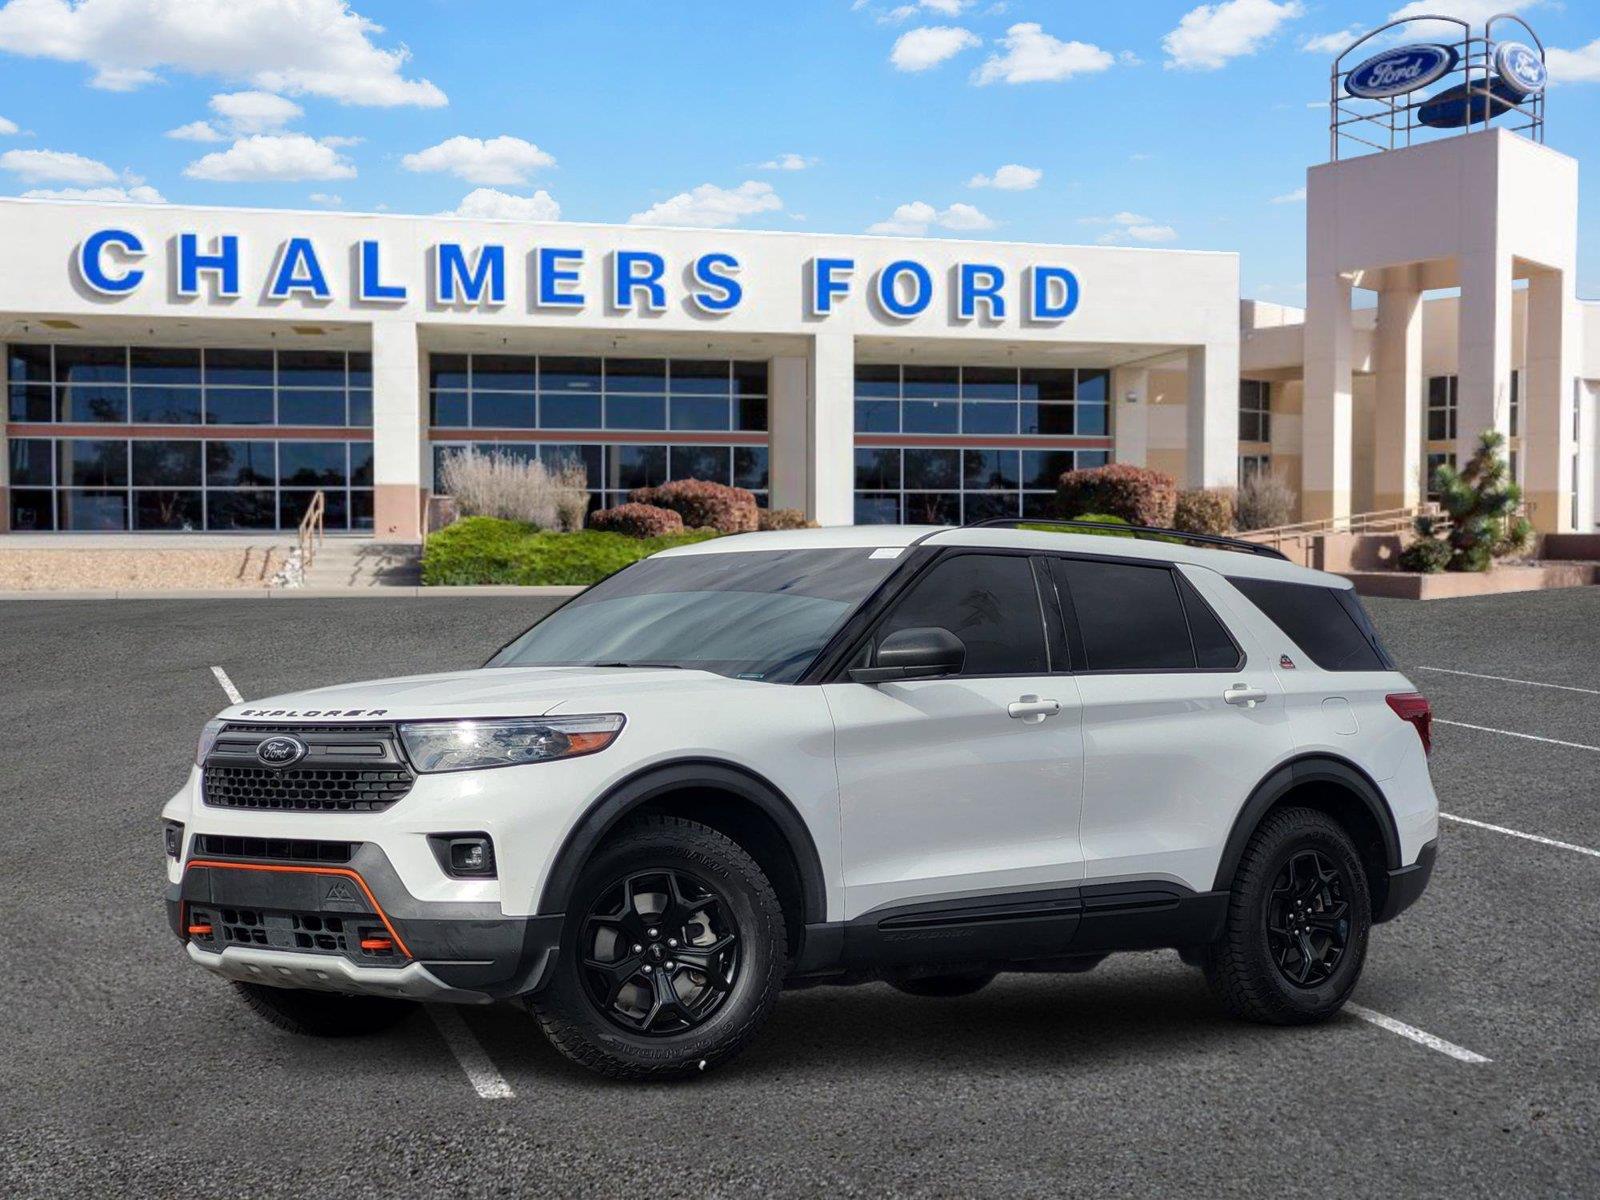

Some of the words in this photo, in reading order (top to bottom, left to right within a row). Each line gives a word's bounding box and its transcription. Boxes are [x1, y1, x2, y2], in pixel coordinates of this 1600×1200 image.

[1367, 56, 1424, 88] Ford
[78, 227, 744, 312] CHALMERS
[812, 257, 1081, 321] FORD
[240, 708, 389, 718] EXPLORER
[263, 741, 290, 759] Ford
